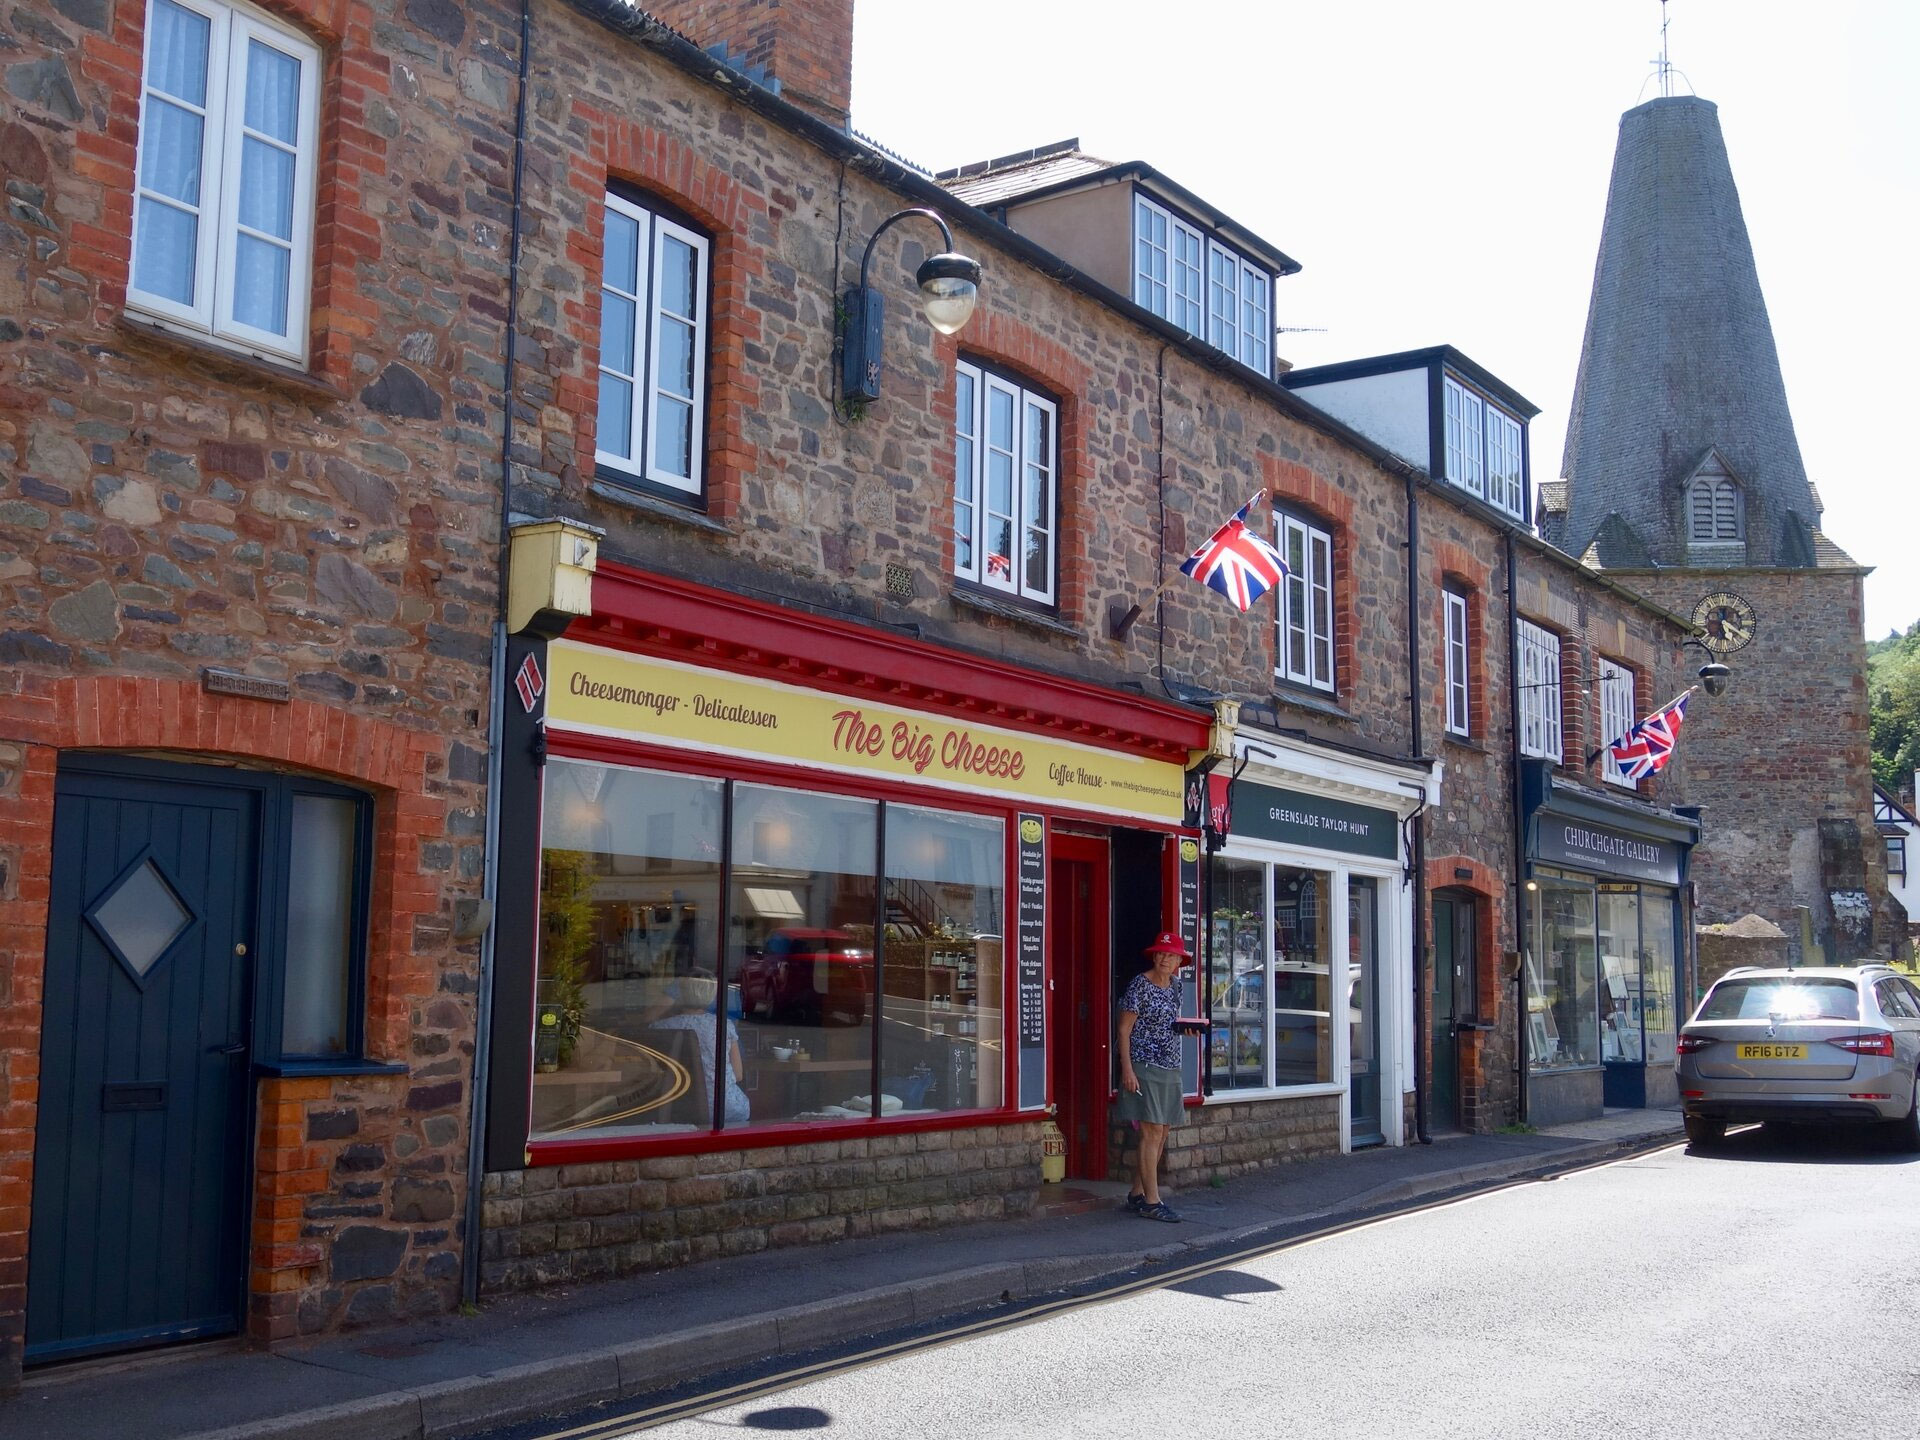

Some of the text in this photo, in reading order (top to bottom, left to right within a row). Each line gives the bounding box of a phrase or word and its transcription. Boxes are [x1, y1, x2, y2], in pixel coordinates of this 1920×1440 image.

[570, 671, 680, 716] Cheesemonger
[693, 694, 778, 729] Delicatessen
[832, 710, 1026, 780] The Big Cheese
[1049, 762, 1075, 787] Coffee
[1077, 767, 1103, 788] House
[1269, 807, 1369, 836] GREENSLADE TAYLOR HUNT
[1564, 826, 1624, 857] CHURCHGATE
[1626, 841, 1660, 863] GALLERY
[1744, 1046, 1800, 1057] RF16 GTZ
